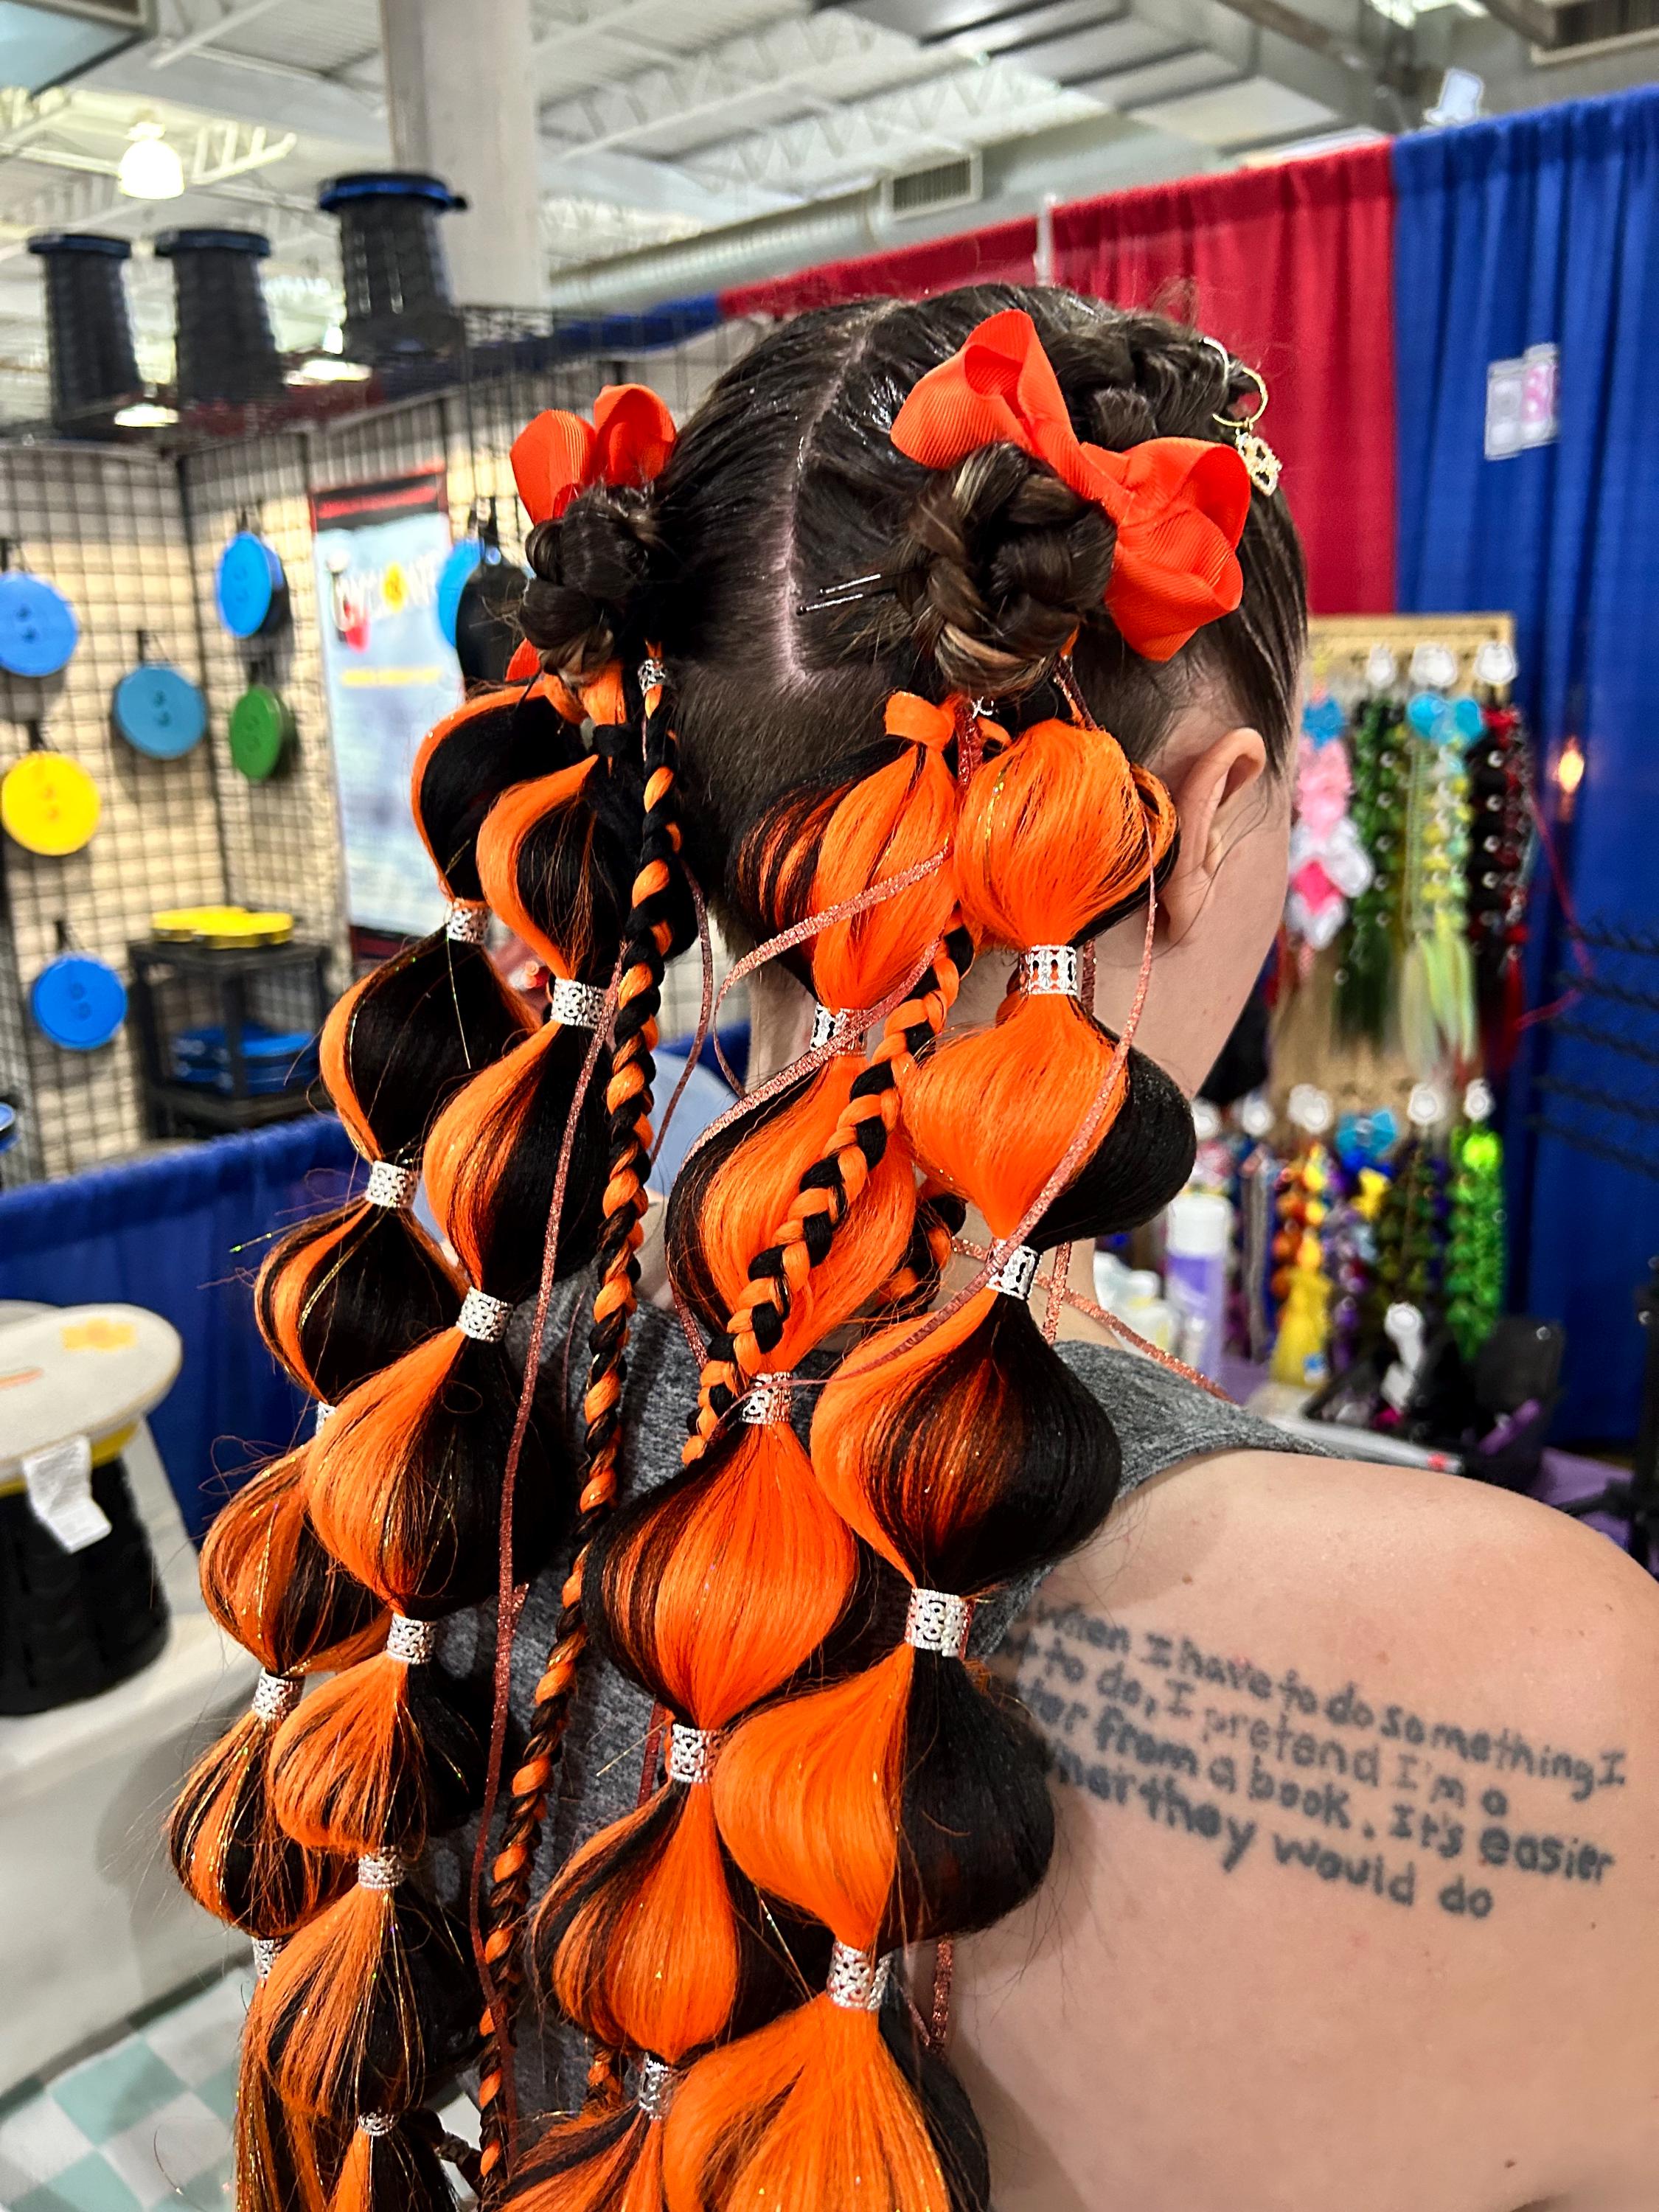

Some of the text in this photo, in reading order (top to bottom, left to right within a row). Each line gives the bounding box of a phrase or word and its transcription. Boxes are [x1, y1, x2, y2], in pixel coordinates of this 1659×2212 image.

[1095, 1703, 1199, 1778] from
[1208, 1755, 1237, 1795] a
[1391, 1802, 1466, 1860] It's
[1478, 1826, 1617, 1886] easier
[1164, 1677, 1194, 1718] I
[1200, 1706, 1380, 1787] pretend
[1395, 1752, 1466, 1809] I'm
[1325, 1680, 1374, 1730] do
[1381, 1705, 1595, 1802] something
[1596, 1750, 1627, 1787] I
[1138, 1773, 1258, 1874] they
[1273, 1832, 1415, 1907] would
[1439, 1873, 1495, 1920] do
